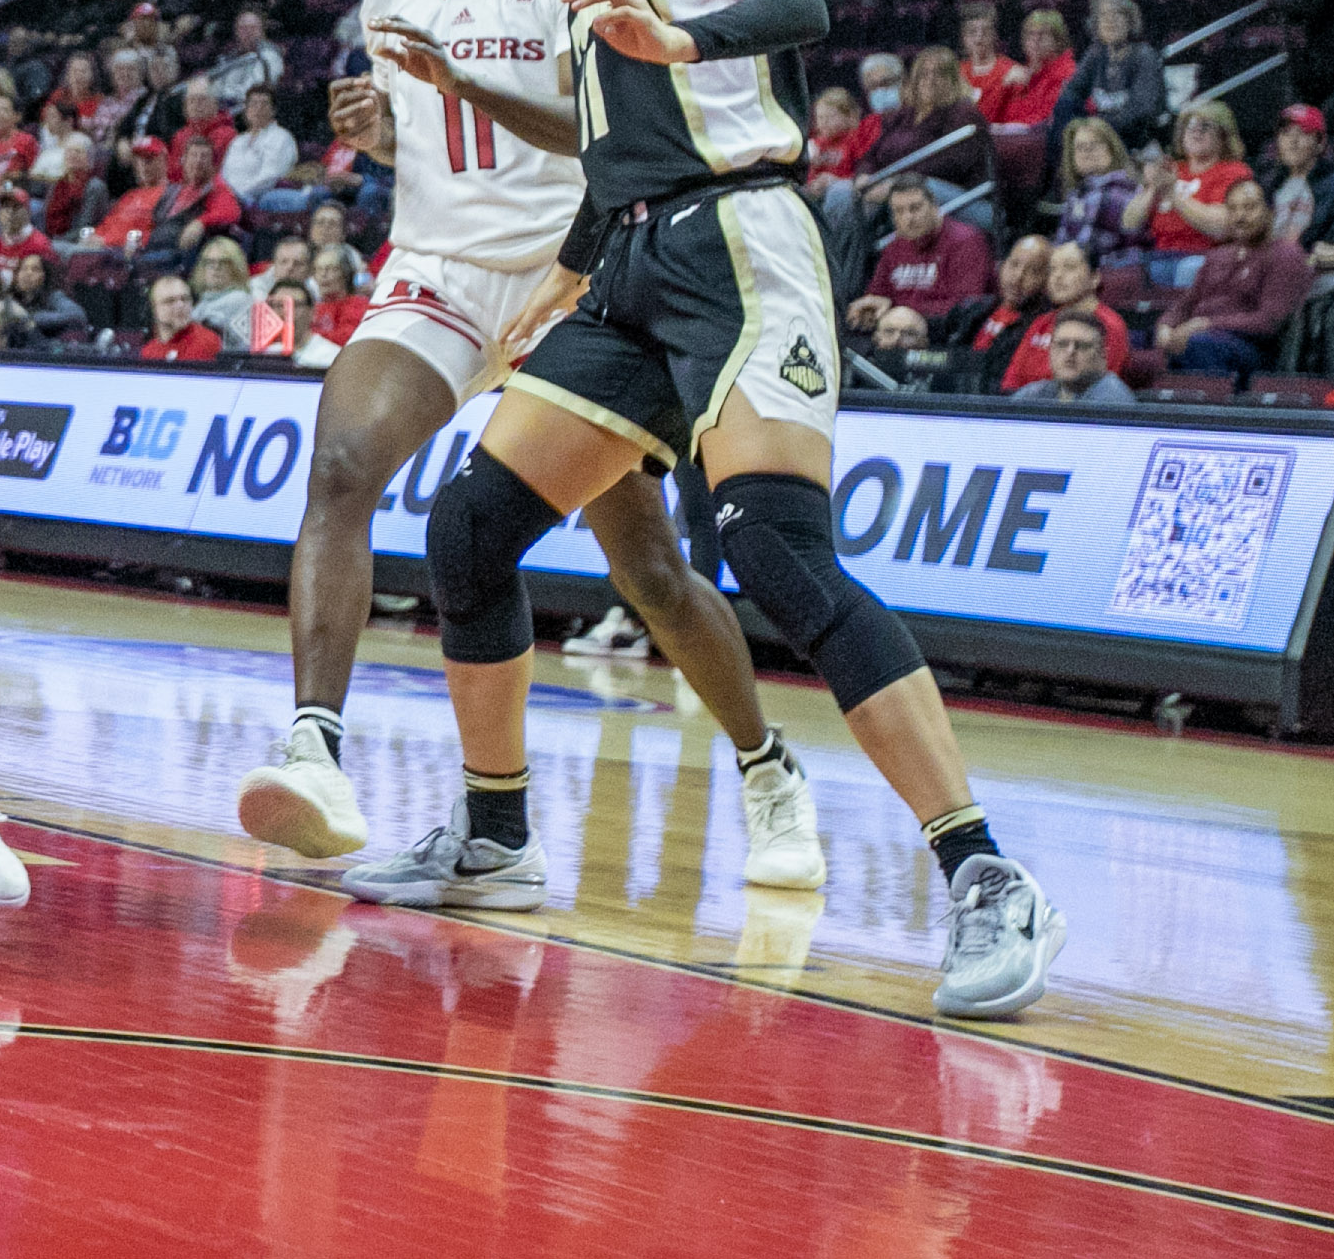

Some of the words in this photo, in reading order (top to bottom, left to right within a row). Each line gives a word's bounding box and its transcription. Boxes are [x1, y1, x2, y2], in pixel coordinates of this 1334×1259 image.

[442, 37, 546, 61] GERS
[13, 430, 56, 471] Play
[89, 464, 165, 490] NETWORK
[833, 458, 1071, 574] OME
